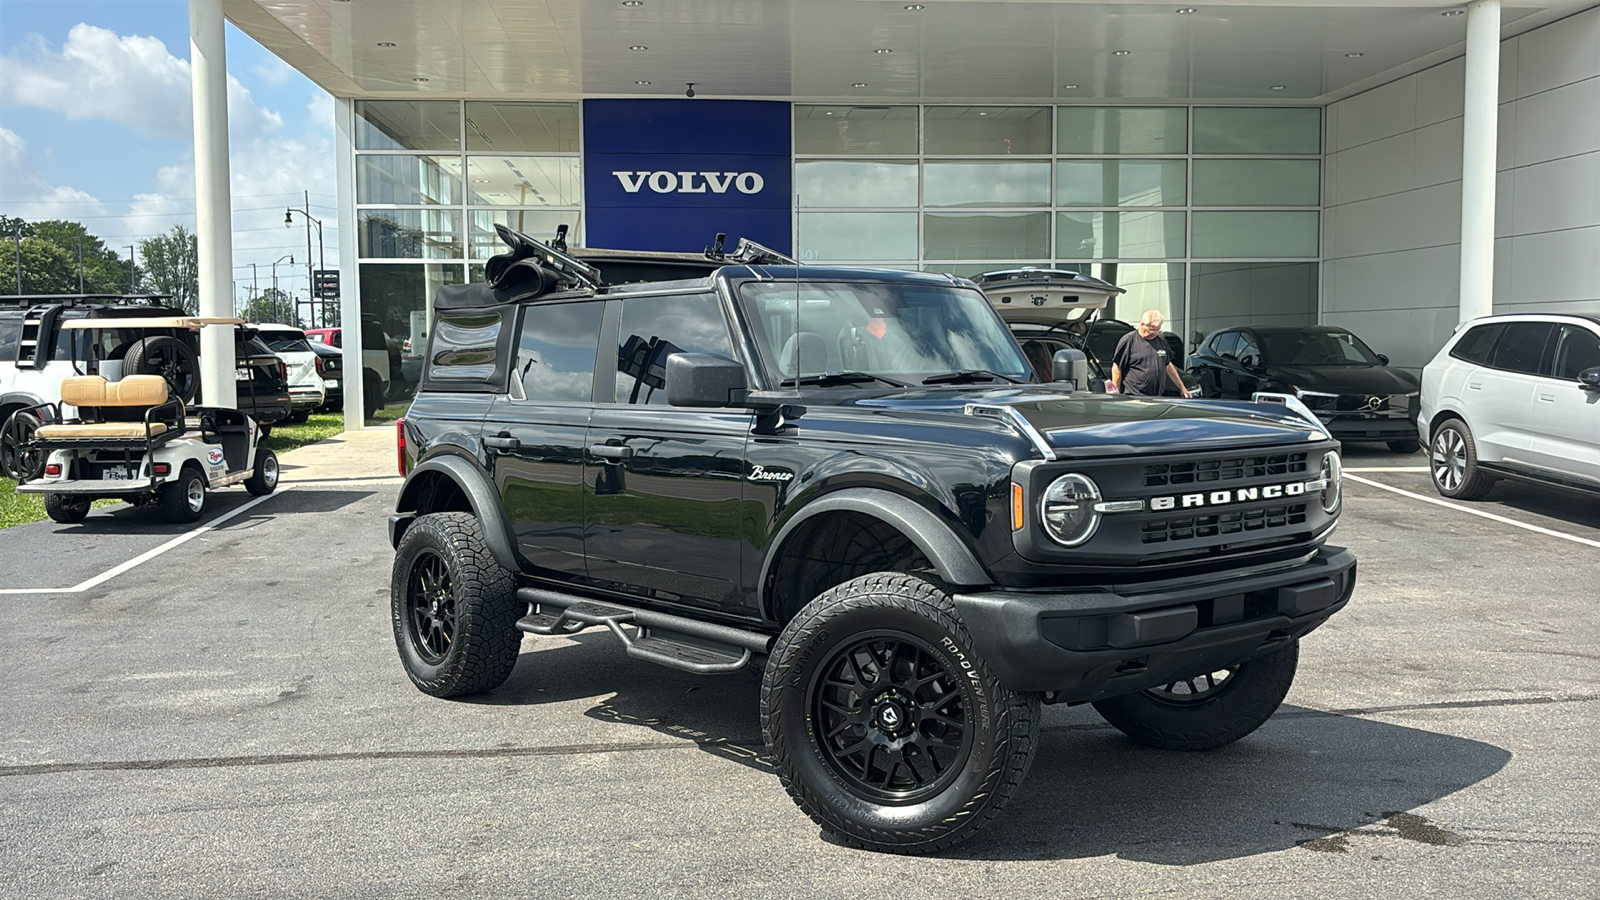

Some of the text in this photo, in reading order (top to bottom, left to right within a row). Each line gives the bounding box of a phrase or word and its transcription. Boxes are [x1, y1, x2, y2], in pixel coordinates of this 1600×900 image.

[612, 170, 765, 194] VOLVO
[747, 464, 794, 480] Bronco
[1150, 482, 1305, 511] BRONCO
